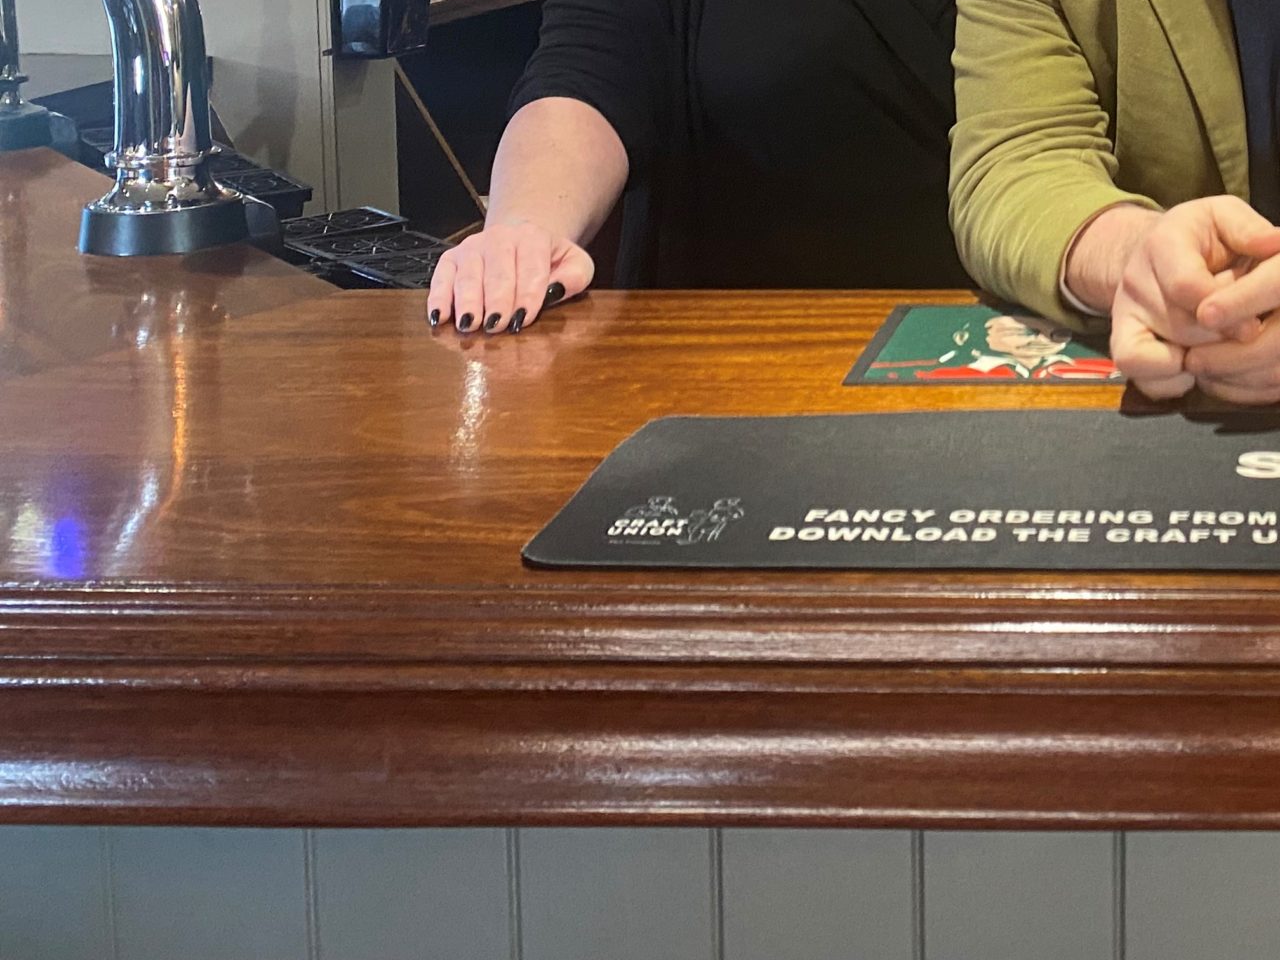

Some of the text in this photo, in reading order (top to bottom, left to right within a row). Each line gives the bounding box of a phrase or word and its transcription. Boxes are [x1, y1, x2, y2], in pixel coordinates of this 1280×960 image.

[804, 509, 936, 523] FANCY
[949, 510, 1154, 524] ORDERING
[1168, 511, 1277, 526] FROM
[607, 527, 682, 536] UNION
[768, 527, 998, 542] DOWNLOAD
[1012, 528, 1091, 543] THE
[1105, 528, 1237, 544] CRAFT
